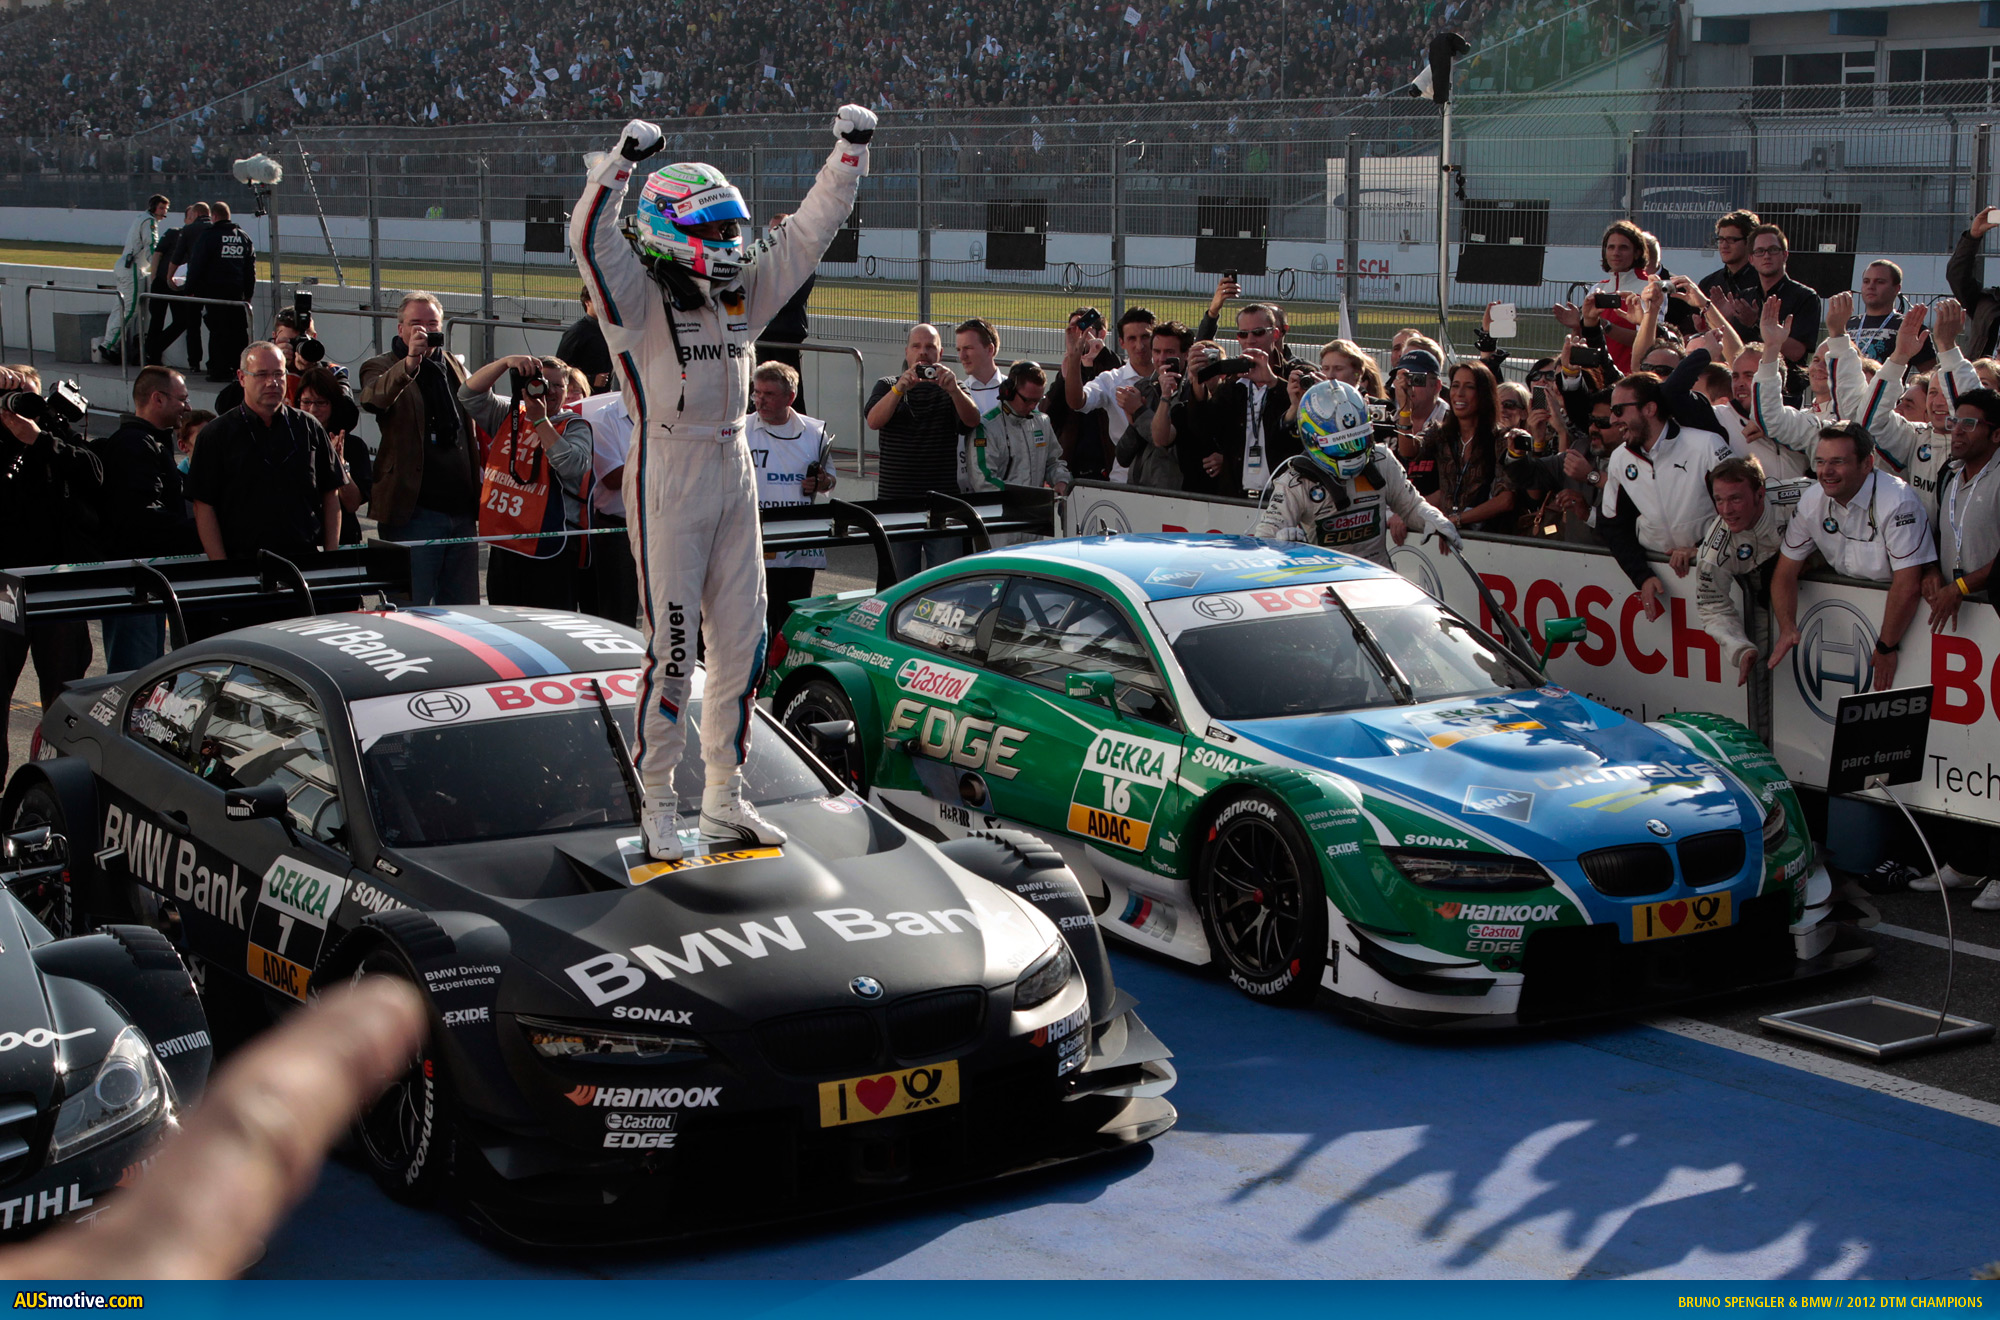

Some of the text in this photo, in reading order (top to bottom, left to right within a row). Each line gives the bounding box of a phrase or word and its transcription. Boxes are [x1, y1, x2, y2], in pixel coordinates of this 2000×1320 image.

[222, 235, 242, 243] DTM
[221, 245, 244, 255] DSO
[1336, 259, 1390, 280] BSCH
[680, 344, 722, 361] BMW
[1913, 475, 1936, 493] BMW
[486, 488, 524, 517] 253
[1335, 512, 1371, 531] Castrol
[1323, 525, 1375, 544] EDGE
[1211, 554, 1359, 572] ultimate
[1152, 570, 1198, 584] ARAL
[846, 611, 880, 631] EDGE
[929, 602, 966, 630] FAR
[1477, 573, 1722, 683] BOSCH
[665, 601, 687, 678] Power
[792, 630, 812, 644] BMW
[845, 645, 872, 663] Castrol
[869, 652, 895, 670] EDGE
[317, 630, 434, 682] Bank
[486, 672, 644, 714] BOSC
[910, 665, 971, 700] Castrol
[1069, 687, 1091, 697] PUMA
[88, 701, 117, 727] EDGE
[1841, 696, 1928, 724] DMSB
[140, 712, 178, 744] Spengler
[885, 698, 1031, 782] EDGE
[1095, 737, 1166, 781] DEKRA
[1841, 745, 1912, 772] parc fermé
[1534, 760, 1722, 792] ultimate
[1102, 775, 1131, 814] 16
[1469, 793, 1529, 812] ARAL
[227, 805, 249, 816] PUMA
[1304, 808, 1360, 822] BMW Driving
[1087, 810, 1131, 846] ADAC
[1310, 816, 1358, 831] Experience
[1159, 837, 1176, 853] PUMA
[1326, 840, 1360, 857] EXIDE
[1403, 833, 1469, 850] SONAX
[103, 803, 173, 890] BMW
[174, 838, 249, 931] Bank
[268, 863, 333, 920] DEKRA
[1016, 881, 1044, 894] BMW
[1058, 914, 1095, 929] EXIDE
[1481, 926, 1521, 938] Castrol
[276, 912, 295, 956] 7
[1464, 941, 1524, 954] EDGE
[563, 915, 806, 1007] BMW
[262, 951, 299, 997] ADAC
[424, 964, 501, 982] BMW Driving
[428, 975, 496, 993] Experience
[442, 1006, 489, 1025] EXIDE
[612, 1005, 693, 1026] SONAX
[155, 1029, 211, 1059] SYNTIUM
[1065, 1032, 1086, 1054] Castrol
[1057, 1048, 1087, 1077] EDGE
[622, 1114, 672, 1129] Castrol
[602, 1132, 678, 1149] EDGE
